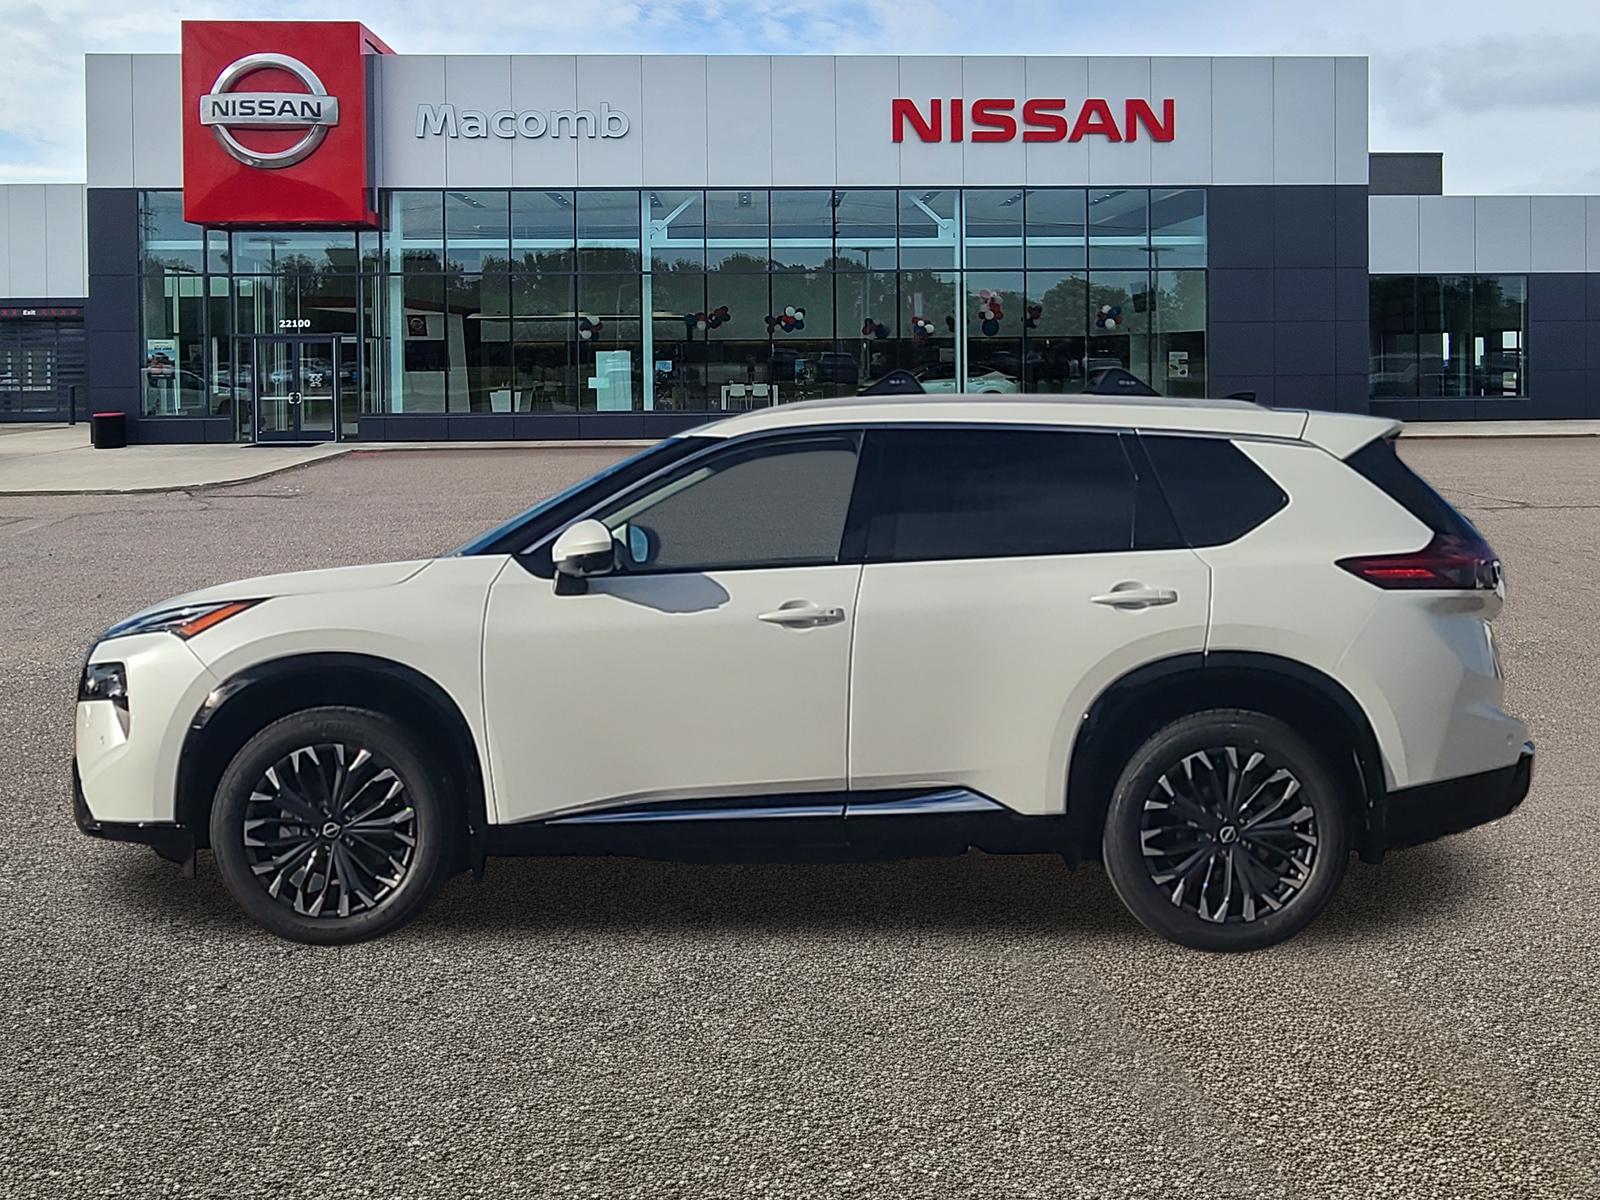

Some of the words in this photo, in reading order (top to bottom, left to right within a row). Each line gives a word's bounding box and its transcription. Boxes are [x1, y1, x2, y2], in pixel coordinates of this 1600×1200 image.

[211, 99, 322, 118] NISSAN
[415, 102, 630, 139] Macomb
[892, 98, 1175, 143] NISSAN
[279, 319, 311, 328] 22100
